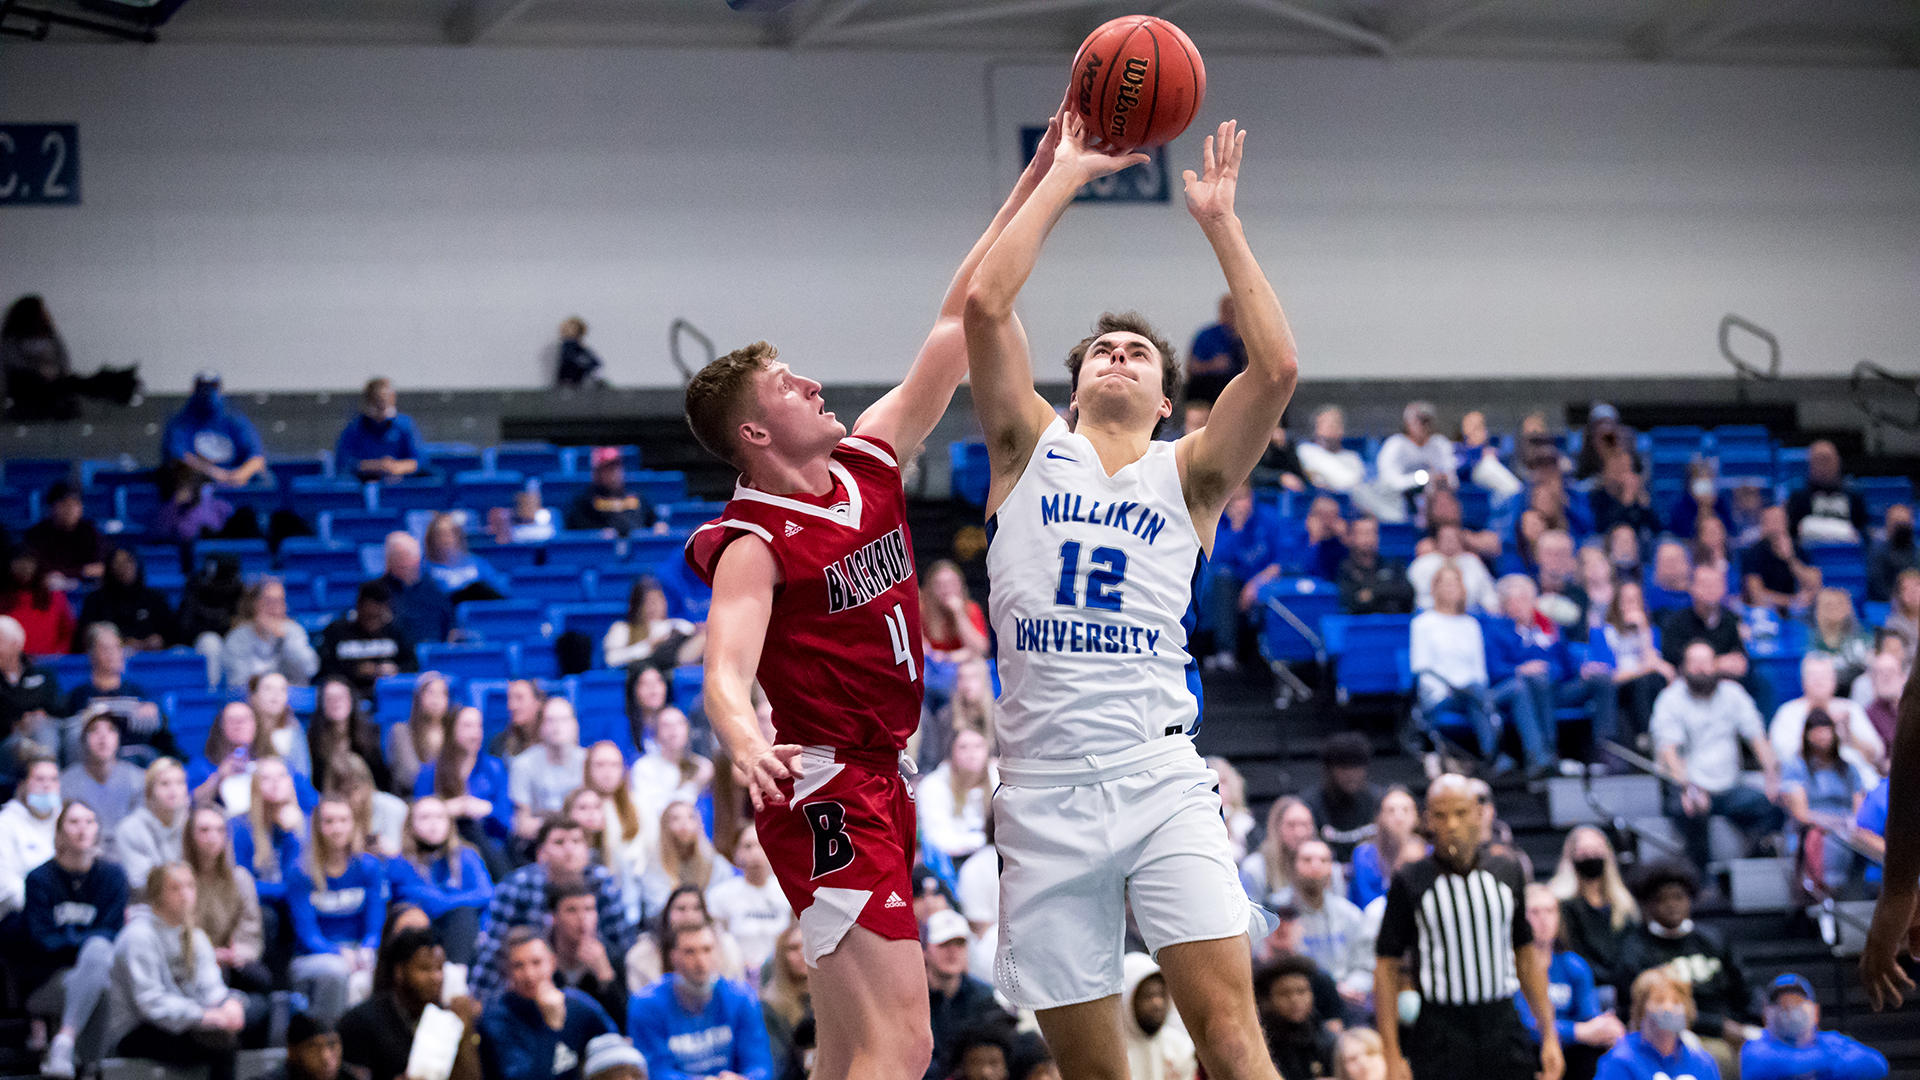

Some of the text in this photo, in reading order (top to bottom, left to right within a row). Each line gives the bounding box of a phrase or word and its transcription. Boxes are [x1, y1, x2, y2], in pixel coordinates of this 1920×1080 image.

[1110, 56, 1150, 137] Wilson
[41, 131, 69, 197] 2
[1041, 492, 1166, 546] MILLIKIN
[1053, 538, 1130, 613] 12
[884, 602, 918, 683] 4
[1015, 616, 1160, 656] UNIVERSITY
[803, 801, 855, 881] B
[884, 900, 907, 908] adidas
